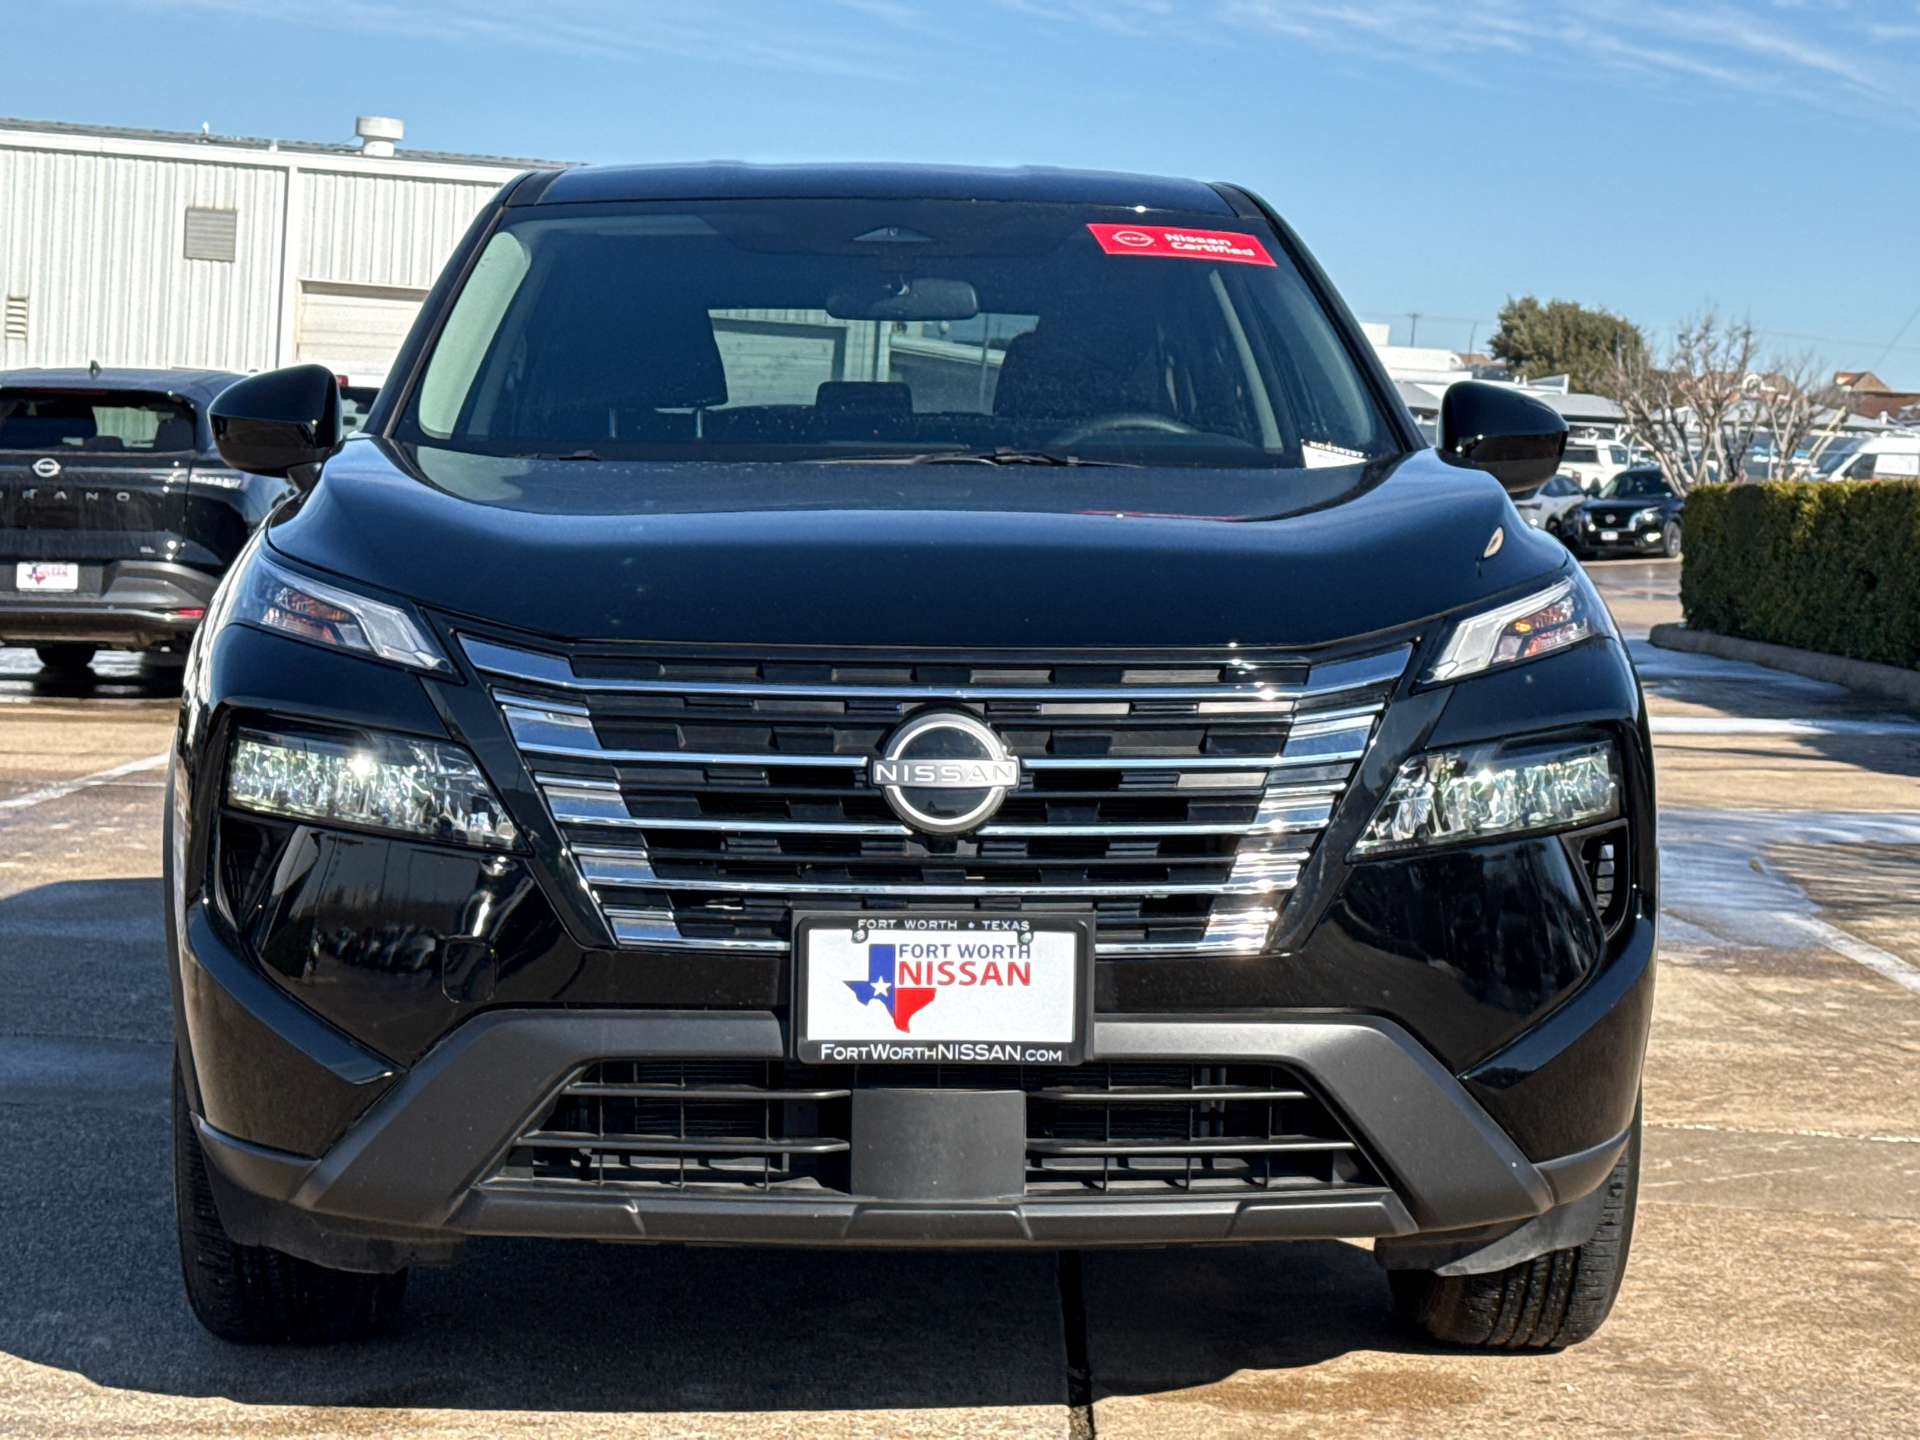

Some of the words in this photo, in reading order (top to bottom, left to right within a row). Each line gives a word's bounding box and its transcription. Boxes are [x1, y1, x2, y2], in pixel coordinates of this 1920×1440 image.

[1164, 233, 1232, 247] Nissan
[1170, 242, 1256, 257] Certified
[875, 764, 1013, 782] NISSAN
[857, 919, 898, 930] FORT
[904, 919, 958, 930] WORTH
[981, 920, 1031, 931] TEXAS
[898, 943, 952, 959] FORT
[958, 943, 1032, 960] WORTH
[898, 960, 1032, 987] NISSAN
